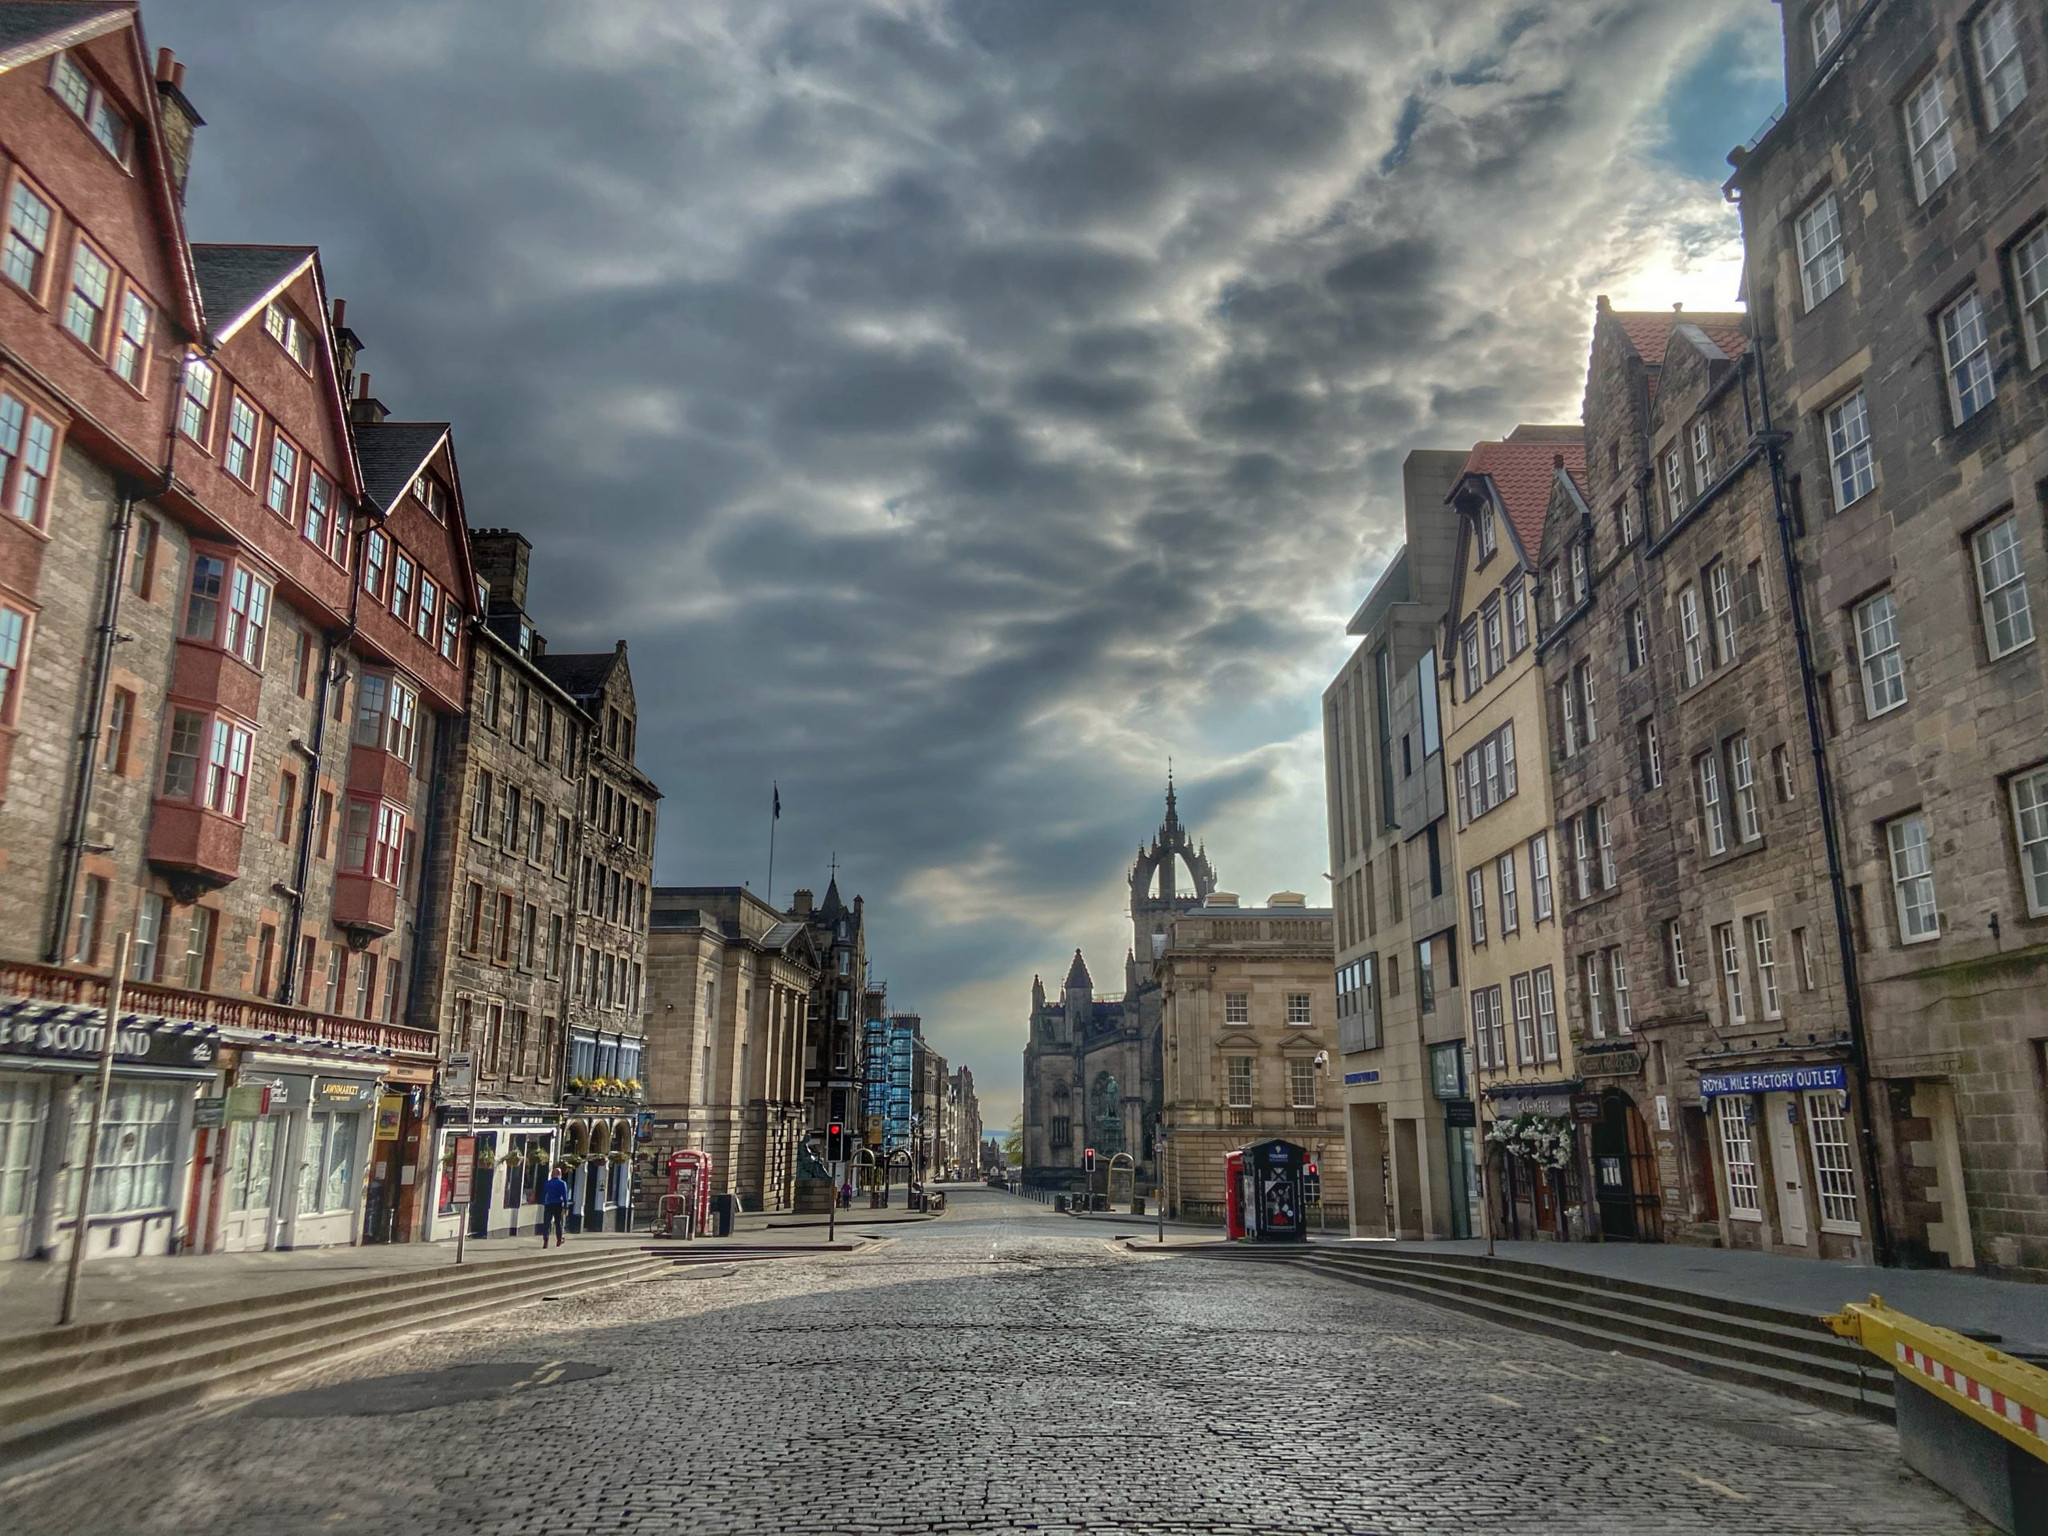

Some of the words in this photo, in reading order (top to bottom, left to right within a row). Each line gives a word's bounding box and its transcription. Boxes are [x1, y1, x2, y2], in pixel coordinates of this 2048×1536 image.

[15, 1023, 39, 1043] OF
[1702, 1079, 1728, 1092] ROYAL
[1730, 1076, 1750, 1090] MILE
[1752, 1073, 1794, 1088] FACTORY
[1797, 1070, 1837, 1085] OUTLET
[1517, 1101, 1551, 1113] CASHMERE
